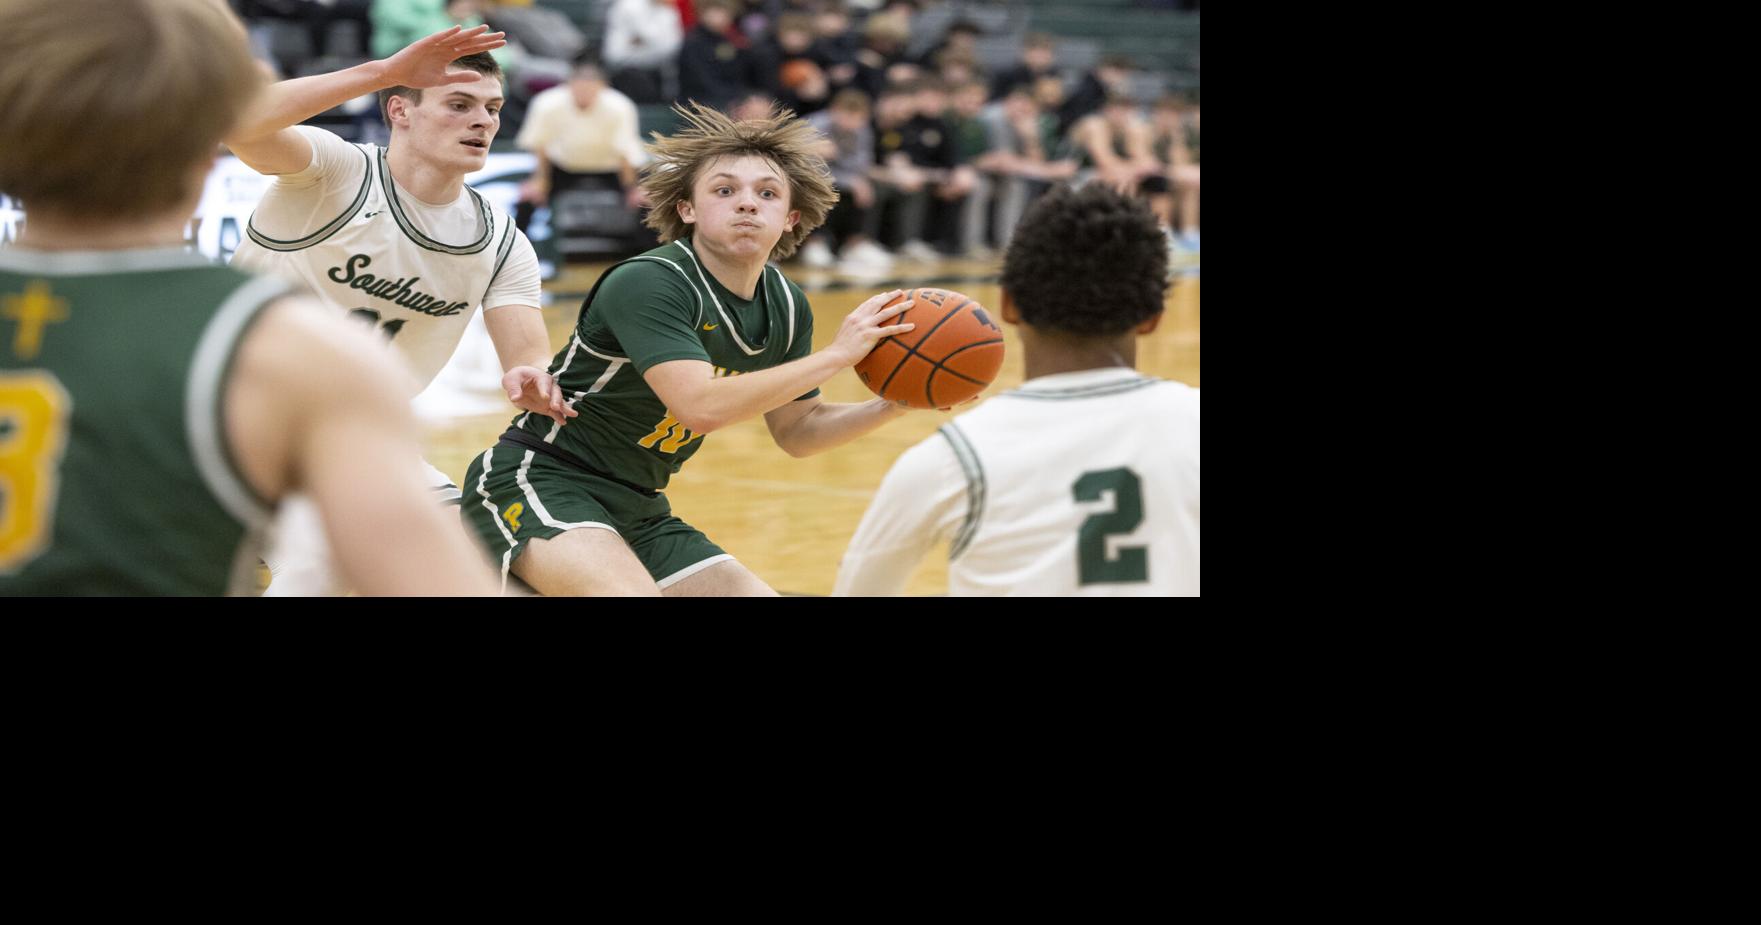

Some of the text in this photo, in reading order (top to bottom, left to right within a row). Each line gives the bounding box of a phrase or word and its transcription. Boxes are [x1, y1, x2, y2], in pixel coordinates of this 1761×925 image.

[328, 254, 470, 317] Southwest
[501, 501, 525, 535] P
[1072, 467, 1149, 584] 2
